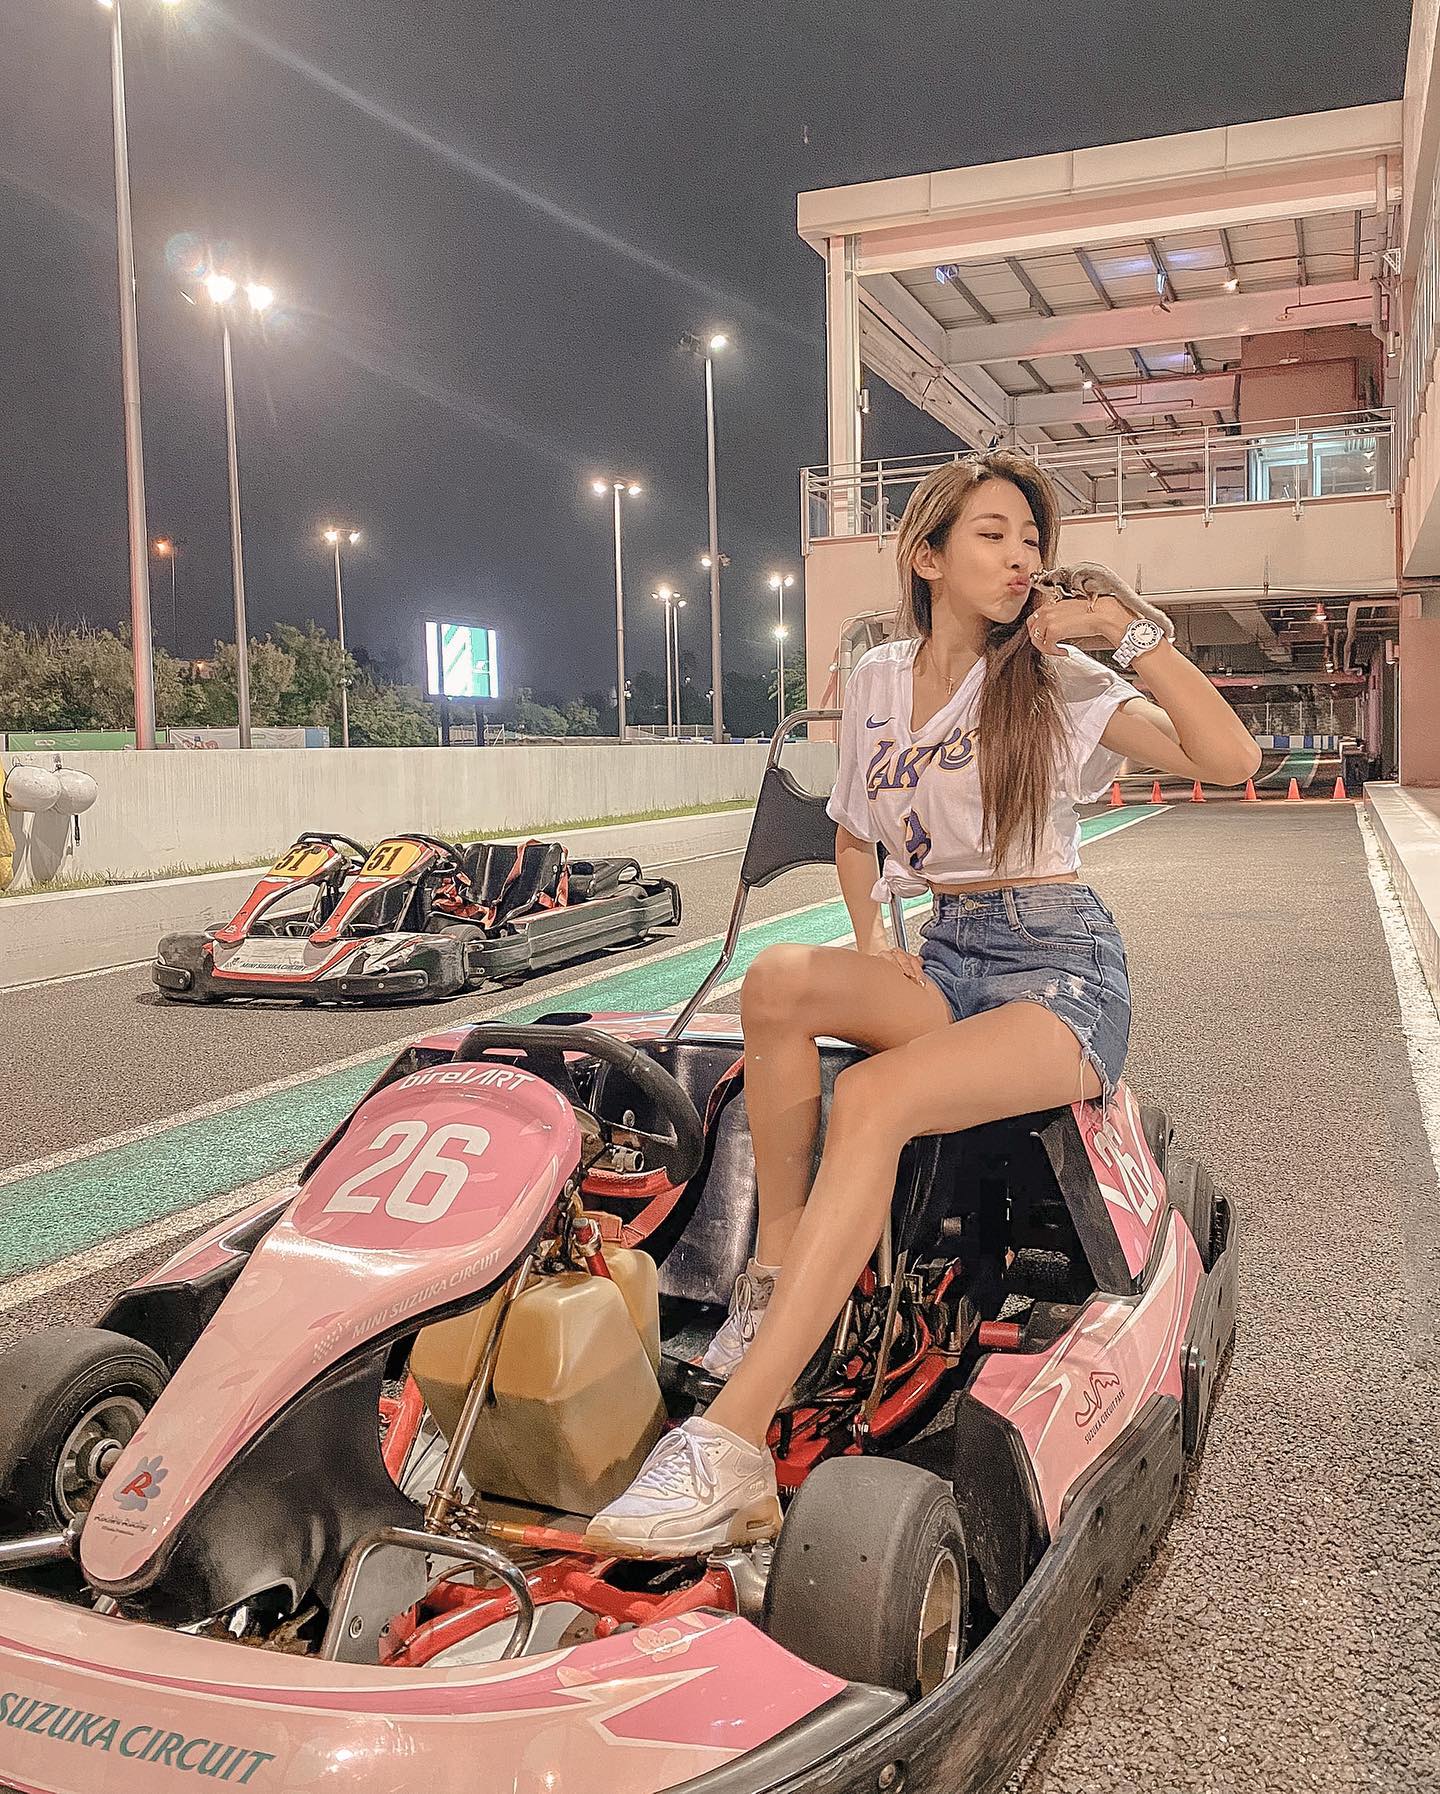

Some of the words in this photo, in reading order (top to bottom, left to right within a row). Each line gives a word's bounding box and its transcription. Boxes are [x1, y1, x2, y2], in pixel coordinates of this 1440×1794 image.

[367, 846, 404, 871] 51
[322, 1120, 491, 1224] 26
[1093, 1118, 1158, 1227] 26
[352, 1309, 388, 1340] MINI
[389, 1279, 448, 1319] SUZUKA
[450, 1247, 502, 1288] CIRCUIT
[121, 1471, 152, 1498] R
[0, 1692, 121, 1752] SUZUKA
[119, 1725, 276, 1785] CIRCUIT
